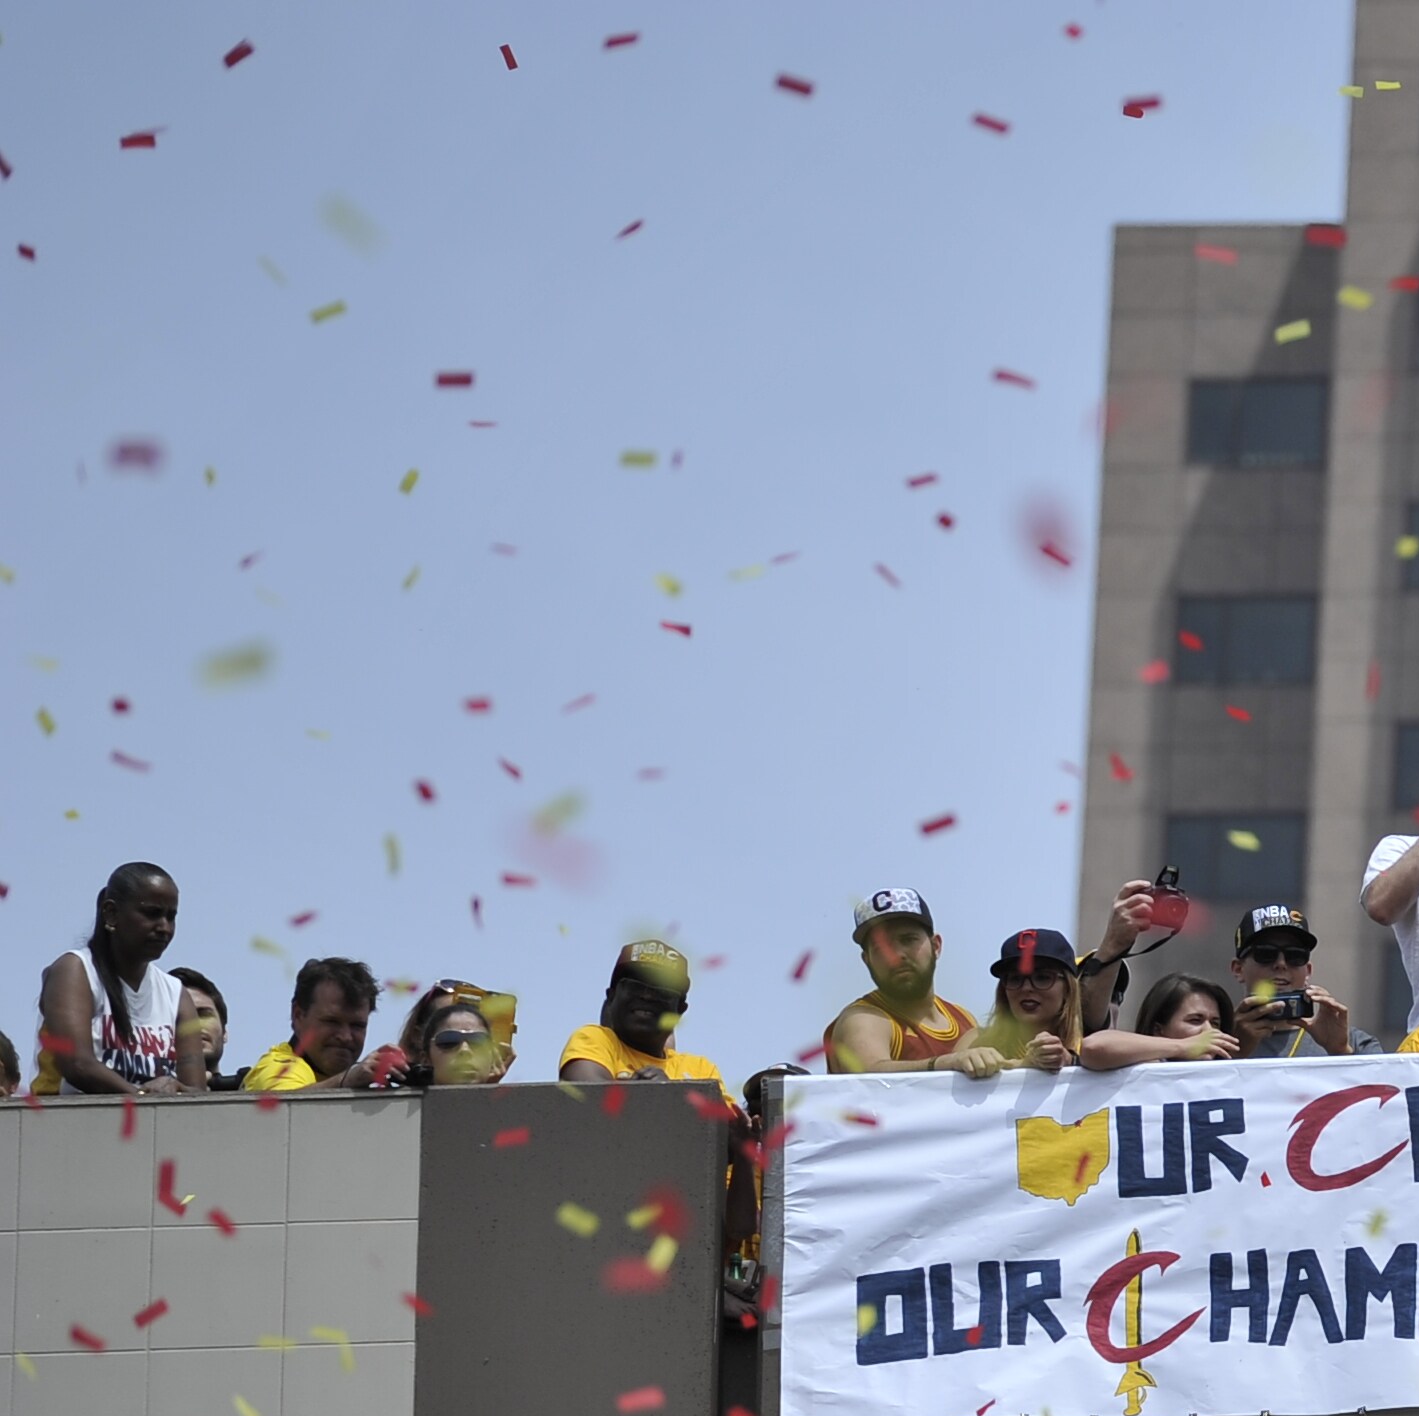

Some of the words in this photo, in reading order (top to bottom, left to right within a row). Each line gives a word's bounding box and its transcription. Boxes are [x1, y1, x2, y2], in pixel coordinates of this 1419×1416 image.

[872, 890, 892, 912] C
[1260, 905, 1290, 919] NBA
[856, 1259, 1067, 1366] OUR
